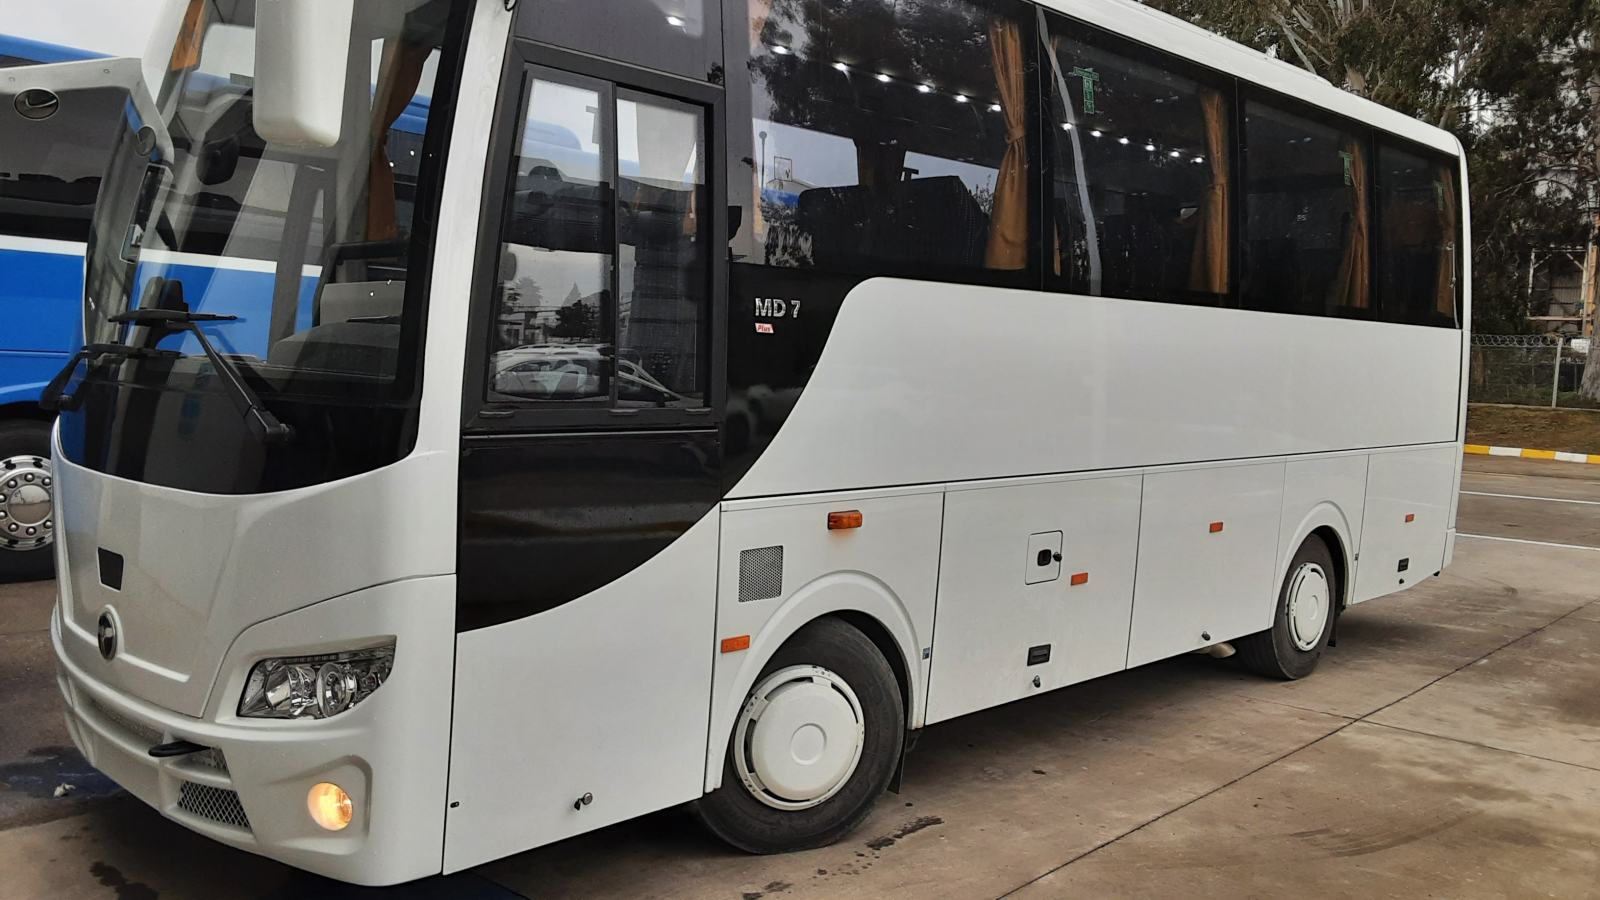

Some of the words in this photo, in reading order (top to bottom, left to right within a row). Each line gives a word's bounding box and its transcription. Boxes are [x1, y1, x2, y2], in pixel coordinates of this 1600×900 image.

[755, 298, 787, 317] MD
[791, 299, 801, 318] 7
[757, 324, 771, 332] Plus
